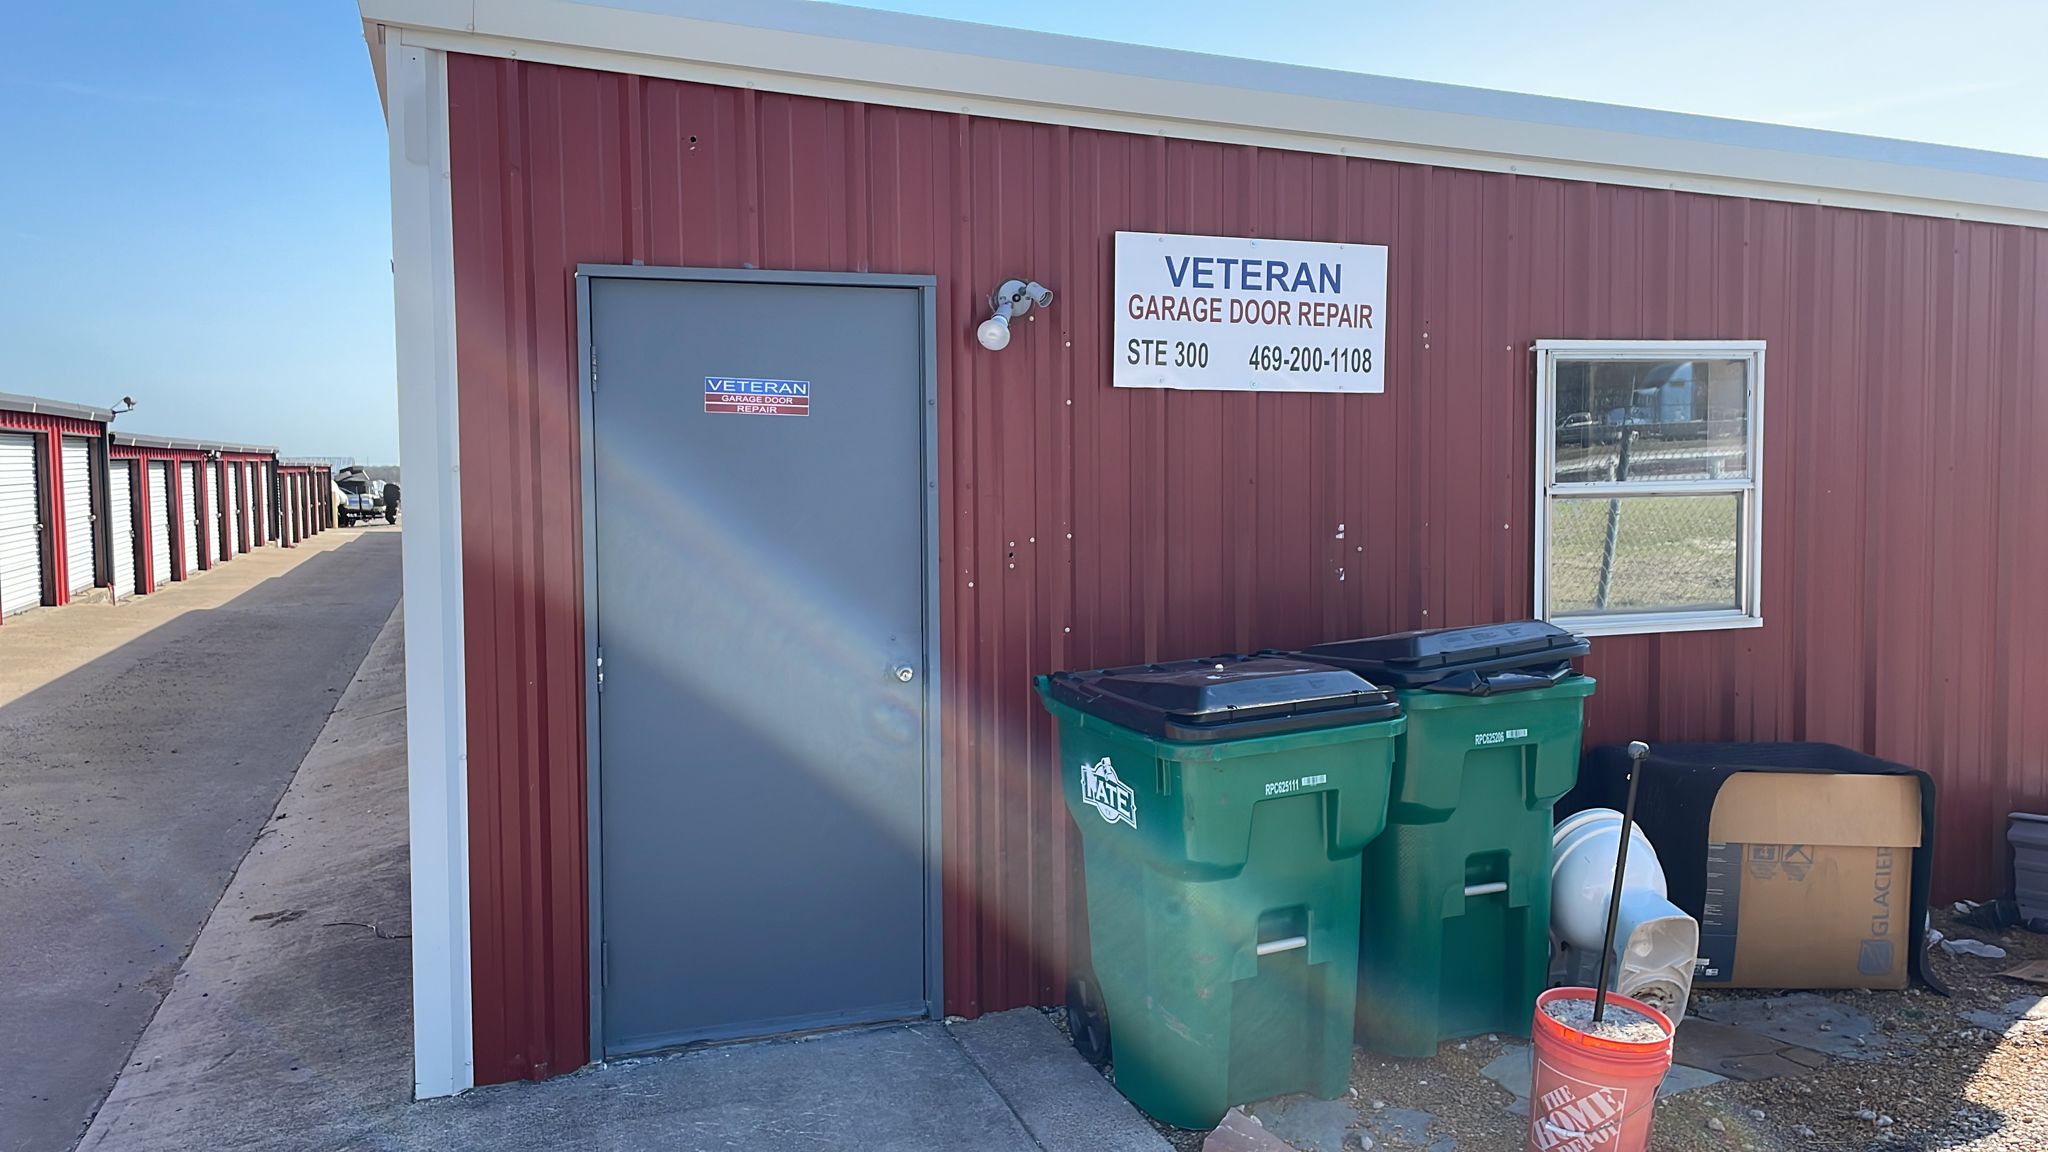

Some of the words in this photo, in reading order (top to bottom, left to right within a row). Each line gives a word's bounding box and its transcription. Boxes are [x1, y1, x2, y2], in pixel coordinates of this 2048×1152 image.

[1164, 255, 1343, 295] VETERAN
[1127, 293, 1223, 324] GARAGE
[1229, 298, 1292, 326] DOOR
[1297, 301, 1374, 329] REPAIR
[1127, 338, 1168, 367] STE
[1174, 341, 1209, 369] 300
[1249, 344, 1373, 374] 469-200-1108
[707, 379, 807, 395] VETERAN
[721, 394, 763, 403] GARAGE
[764, 396, 793, 404] DOOR
[736, 405, 778, 414] REPAIR
[1265, 778, 1299, 796] RPC625111
[1541, 1085, 1577, 1111] THE
[1534, 1087, 1623, 1151] HOME
